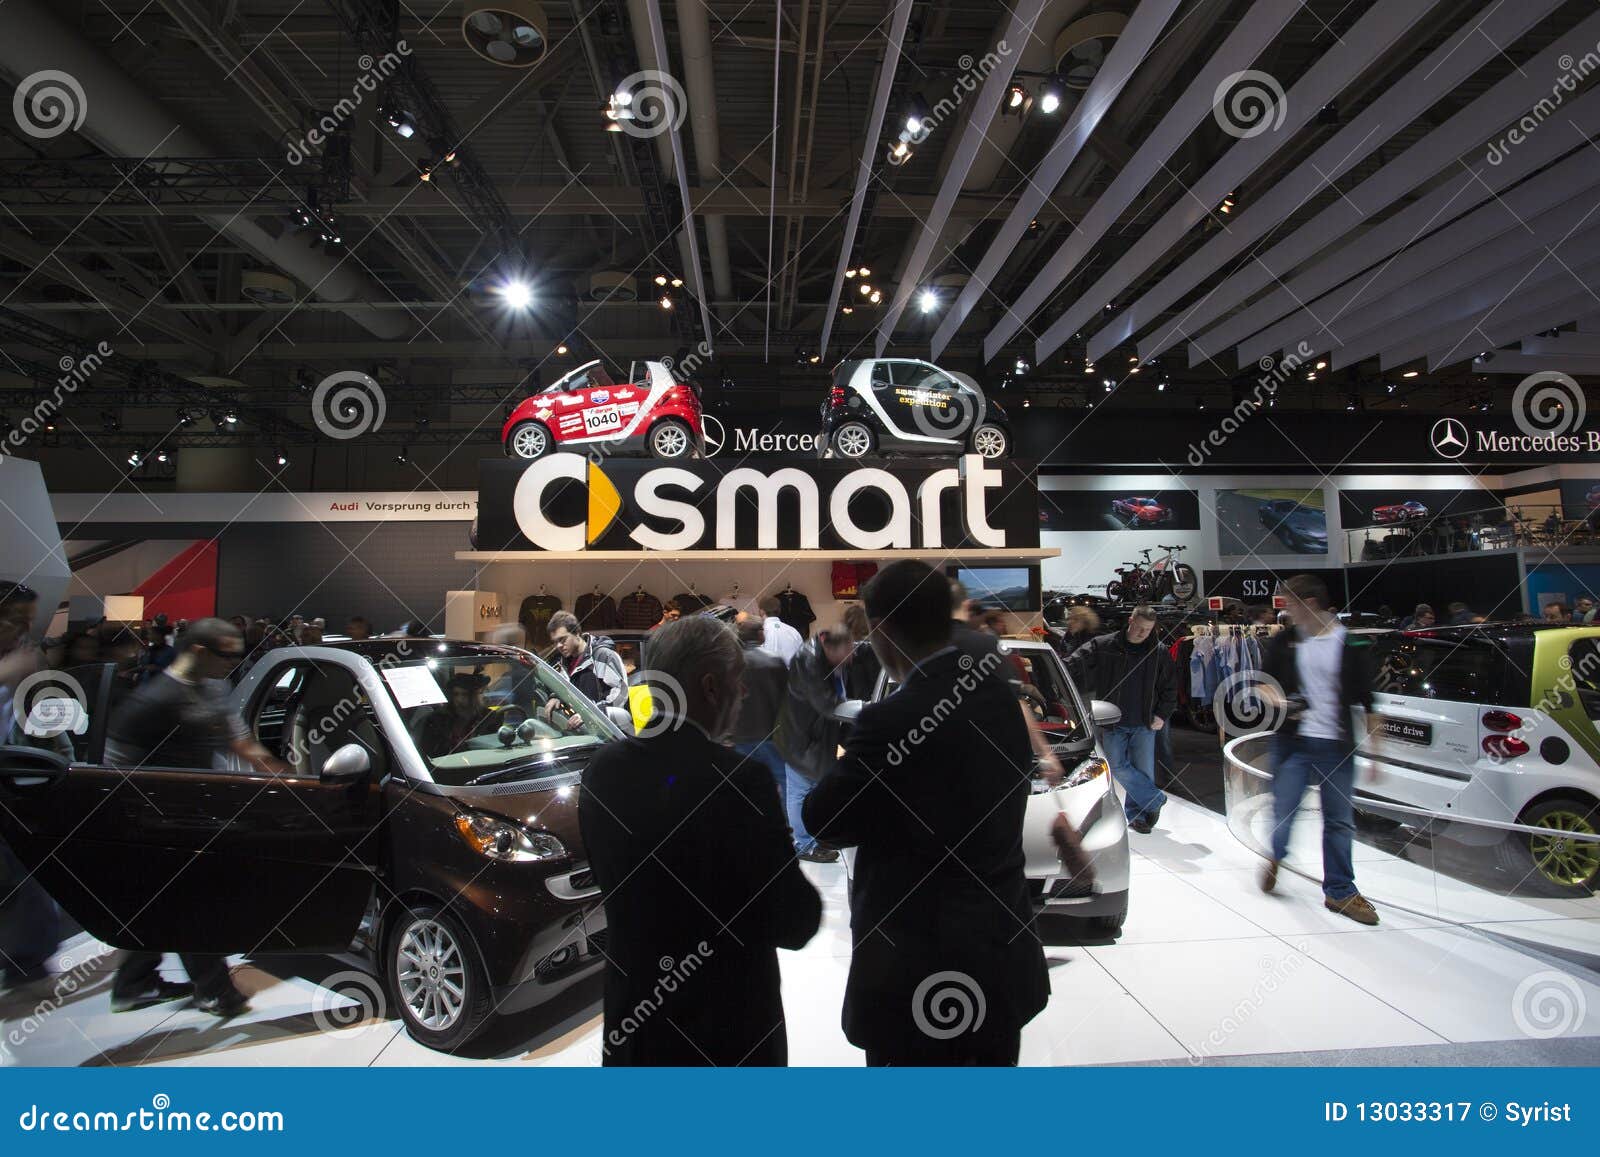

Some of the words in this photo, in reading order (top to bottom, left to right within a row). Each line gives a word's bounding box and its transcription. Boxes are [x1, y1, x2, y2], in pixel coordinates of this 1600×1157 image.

[899, 396, 947, 408] expedition
[586, 412, 618, 428] 1040
[330, 502, 359, 511] Audi
[366, 501, 431, 512] Vorsprung
[435, 501, 470, 510] durch
[628, 454, 1006, 551] smart
[1242, 579, 1269, 596] SLS
[1403, 725, 1424, 737] drive
